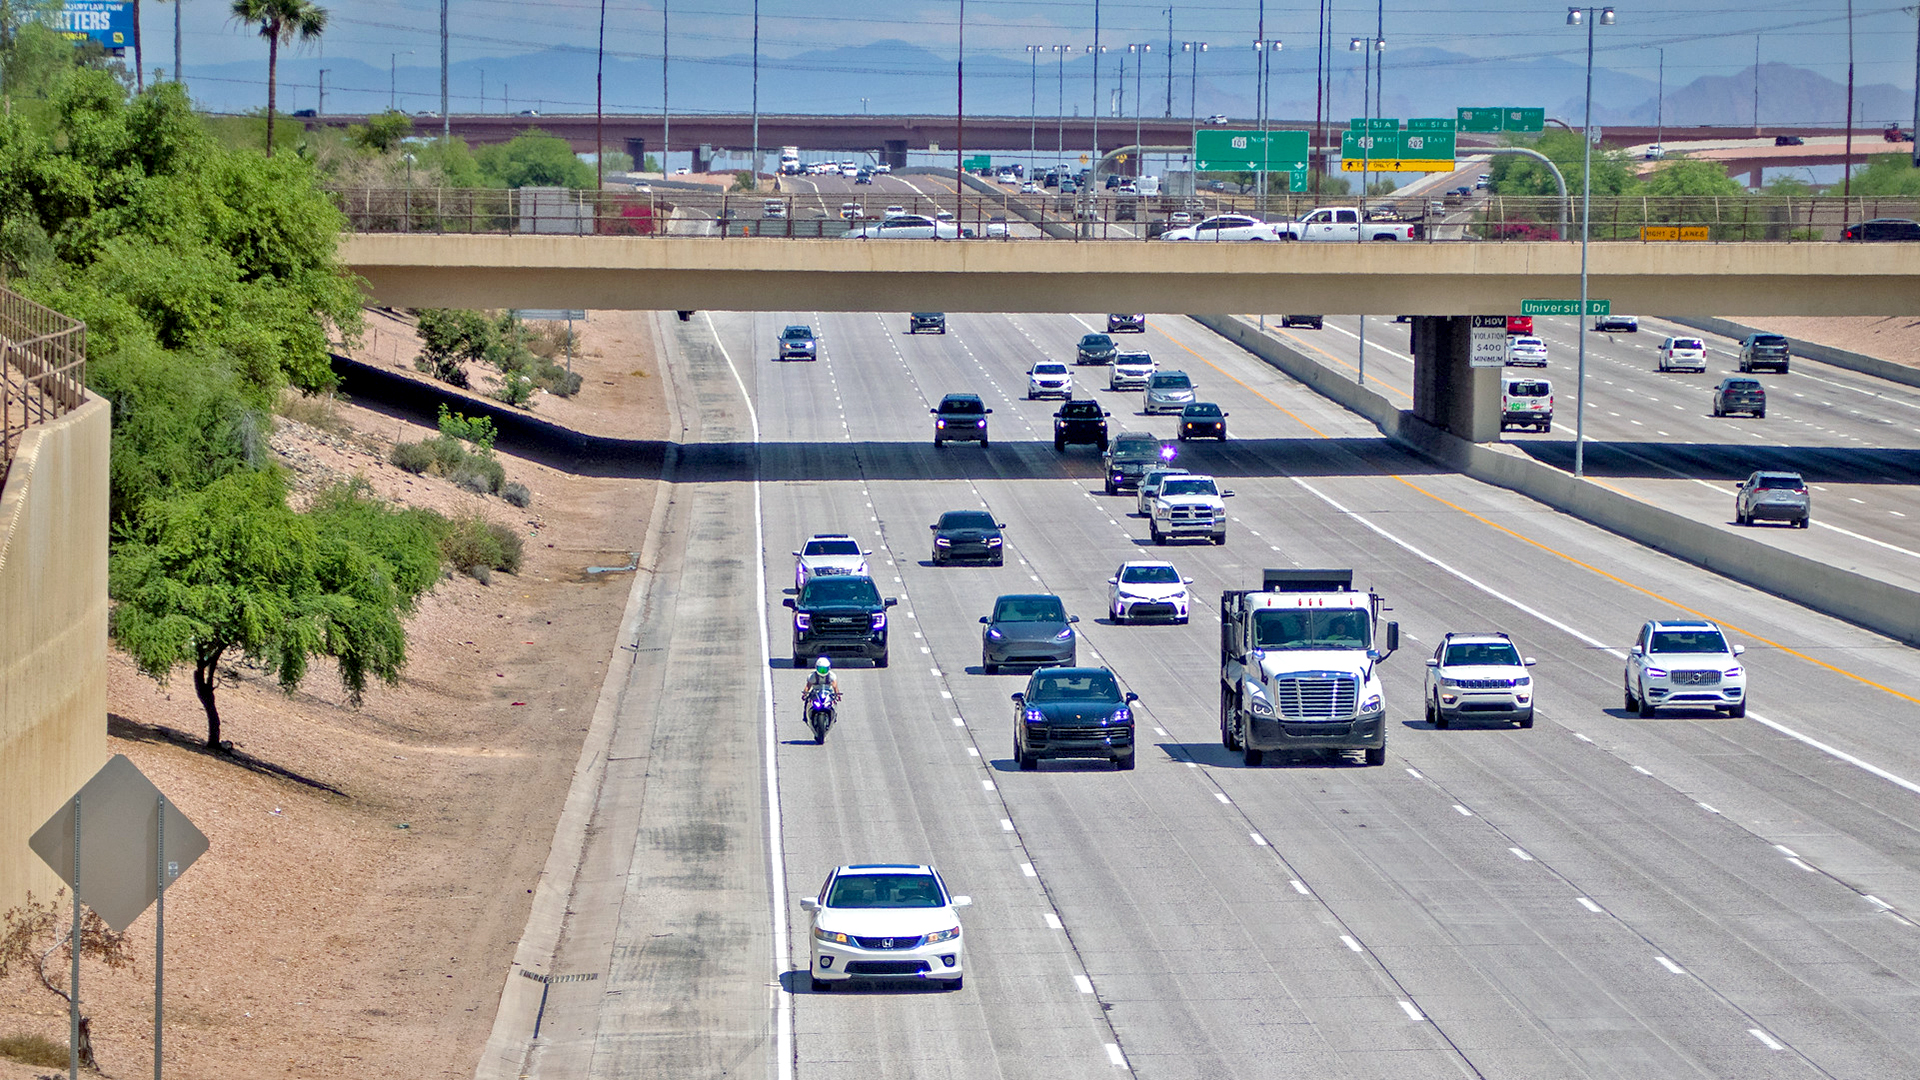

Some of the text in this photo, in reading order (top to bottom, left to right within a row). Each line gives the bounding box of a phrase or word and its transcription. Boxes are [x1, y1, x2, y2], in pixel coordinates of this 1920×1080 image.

[1232, 139, 1246, 148] 101
[1408, 140, 1423, 149] 202
[1525, 303, 1606, 313] Universit Dr
[1484, 317, 1504, 325] HOV
[1473, 332, 1505, 340] VIOLATION
